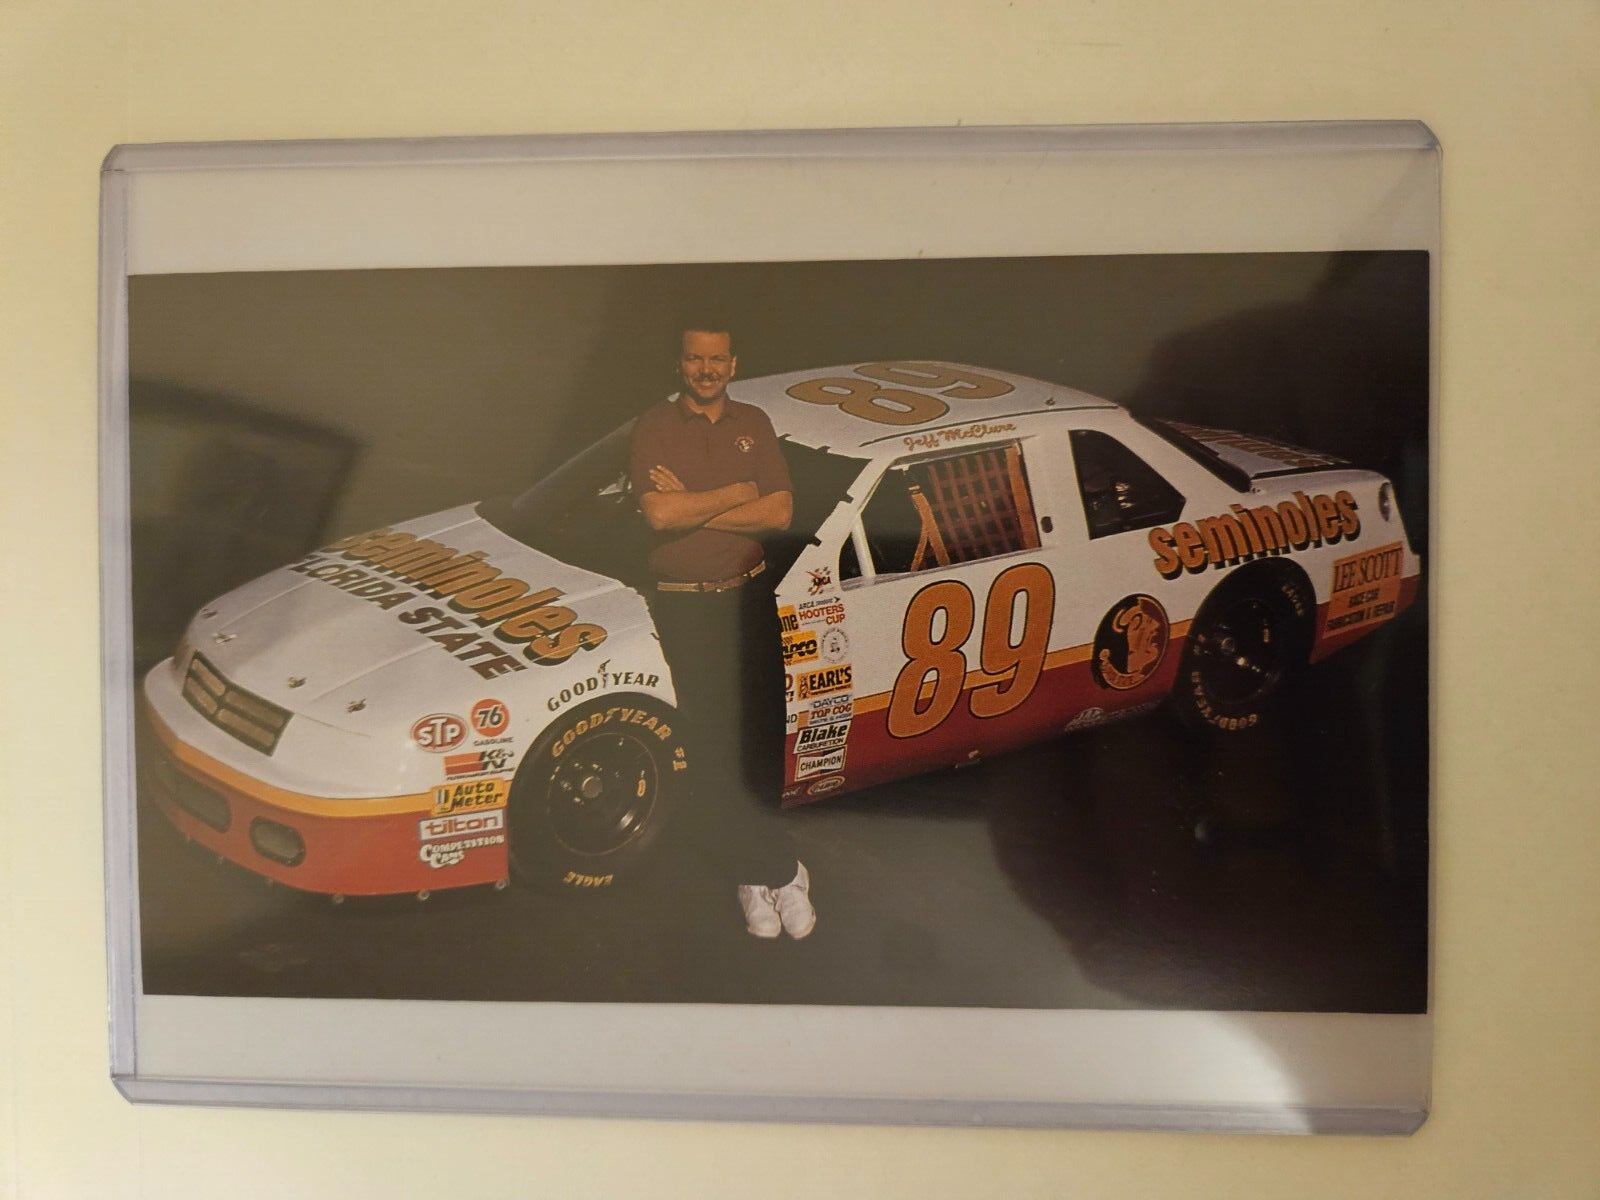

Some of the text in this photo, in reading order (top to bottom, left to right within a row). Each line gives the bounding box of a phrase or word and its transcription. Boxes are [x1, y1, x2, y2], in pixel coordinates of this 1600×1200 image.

[785, 360, 1016, 426] 89
[1148, 490, 1361, 581] seminoles
[1333, 560, 1361, 593] LEE
[799, 603, 844, 620] HOOTERS
[826, 613, 846, 625] CUP
[397, 605, 528, 681] STATE
[887, 562, 1056, 739] 89
[809, 666, 852, 690] EARL'S
[547, 671, 659, 712] GOODYEAR
[478, 705, 503, 728] 76
[811, 703, 852, 720] TOP COG
[417, 717, 461, 748] STP
[799, 724, 848, 745] Blake
[800, 755, 842, 771] CHAMPION
[453, 782, 495, 797] Auto
[450, 793, 504, 812] Meter
[424, 816, 499, 836] tilton
